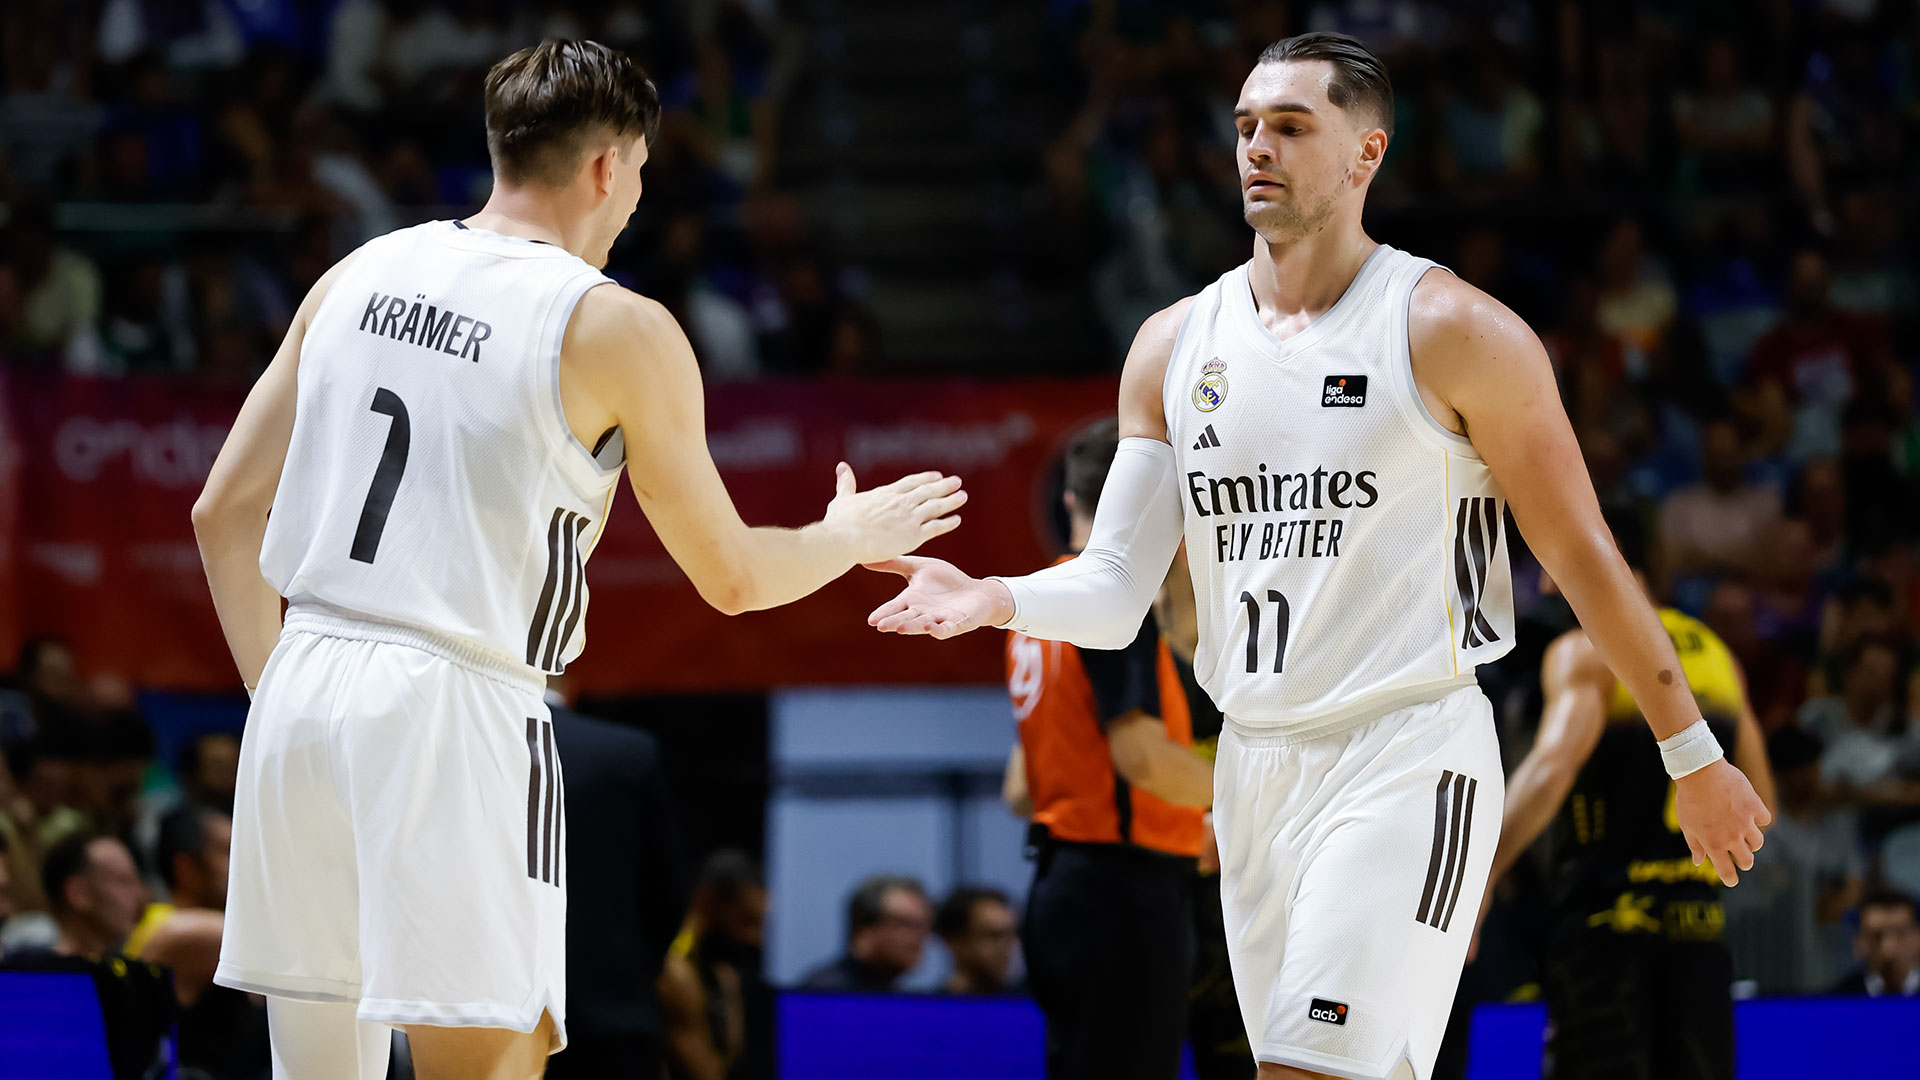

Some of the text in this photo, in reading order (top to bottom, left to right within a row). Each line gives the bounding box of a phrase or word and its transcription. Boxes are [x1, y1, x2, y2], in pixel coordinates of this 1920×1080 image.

[359, 292, 492, 363] KRÄMER
[1324, 393, 1364, 404] endesa
[1325, 384, 1344, 396] liga
[350, 387, 411, 564] 1
[1187, 463, 1379, 517] Emirates
[1216, 519, 1344, 563] FLY BETTER
[1239, 589, 1290, 674] 11
[1311, 1008, 1338, 1022] acb
